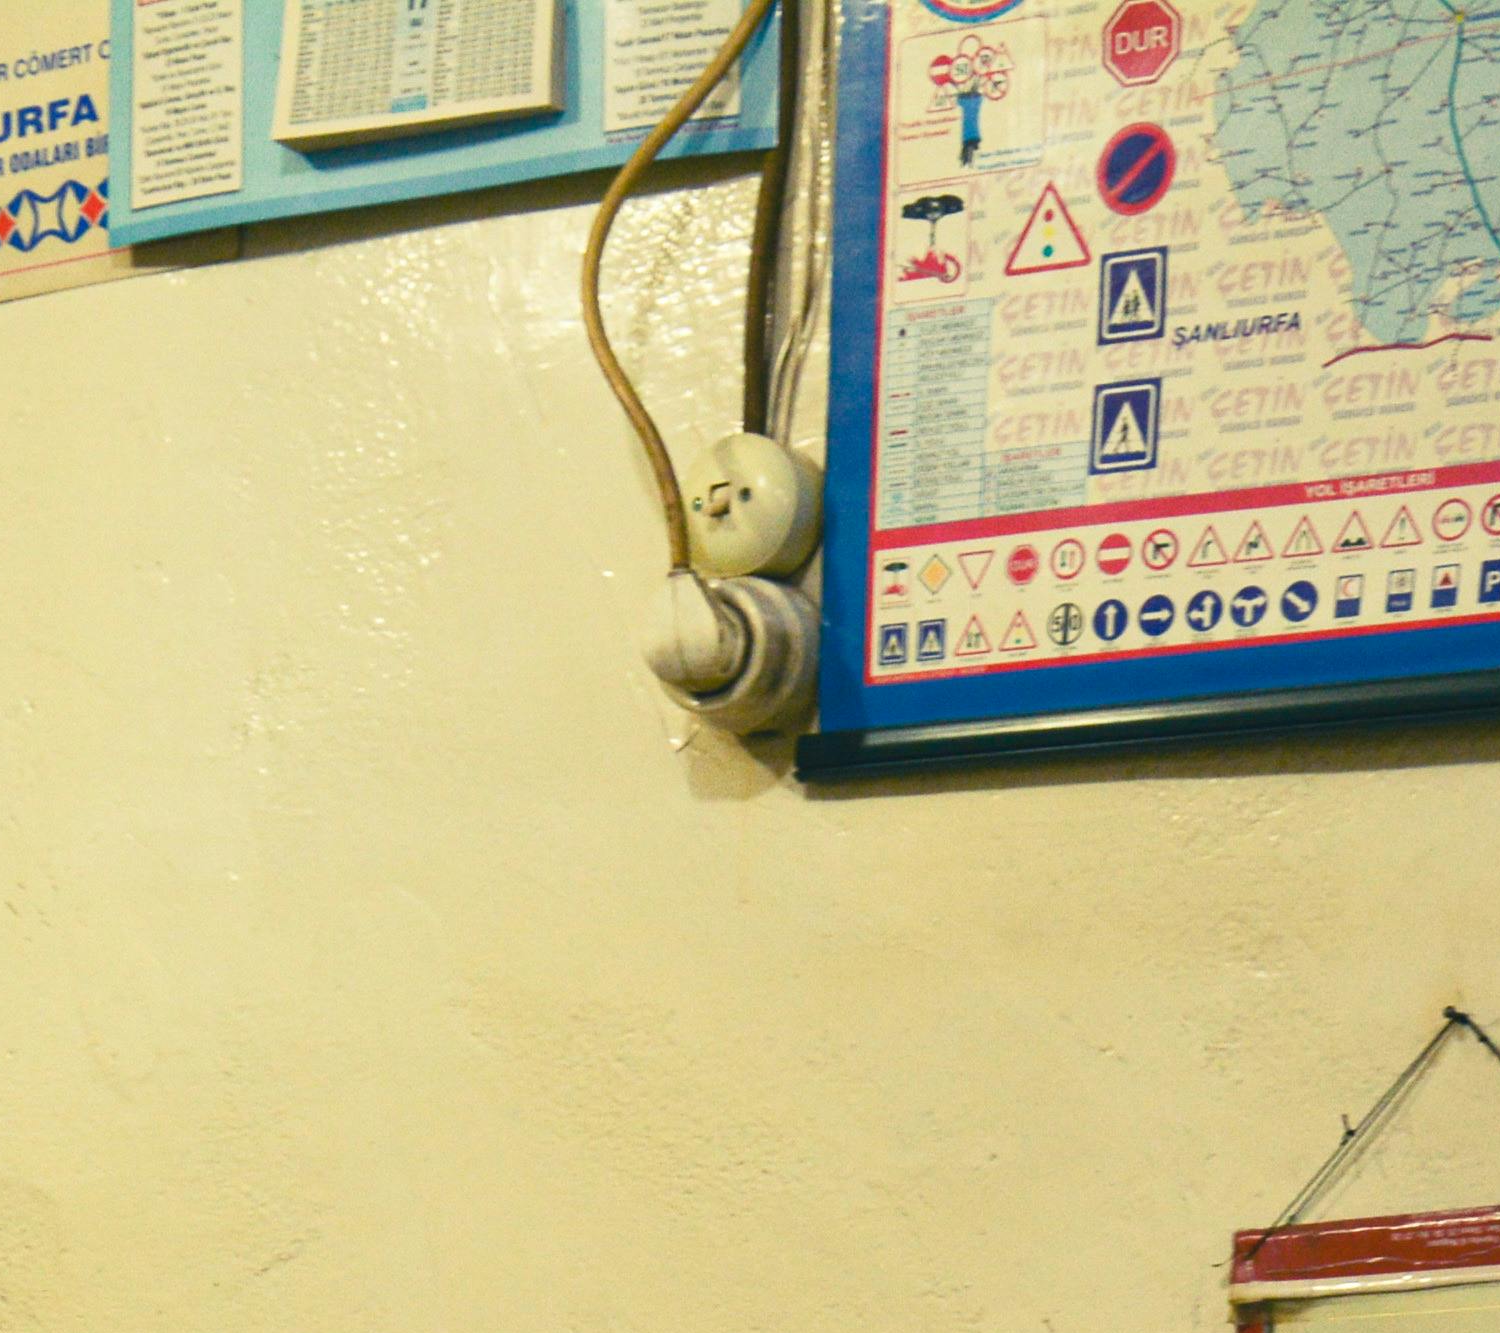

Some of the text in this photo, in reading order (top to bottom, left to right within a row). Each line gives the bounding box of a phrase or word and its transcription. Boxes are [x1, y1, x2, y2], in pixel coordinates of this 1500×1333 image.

[1114, 26, 1169, 56] DUR
[14, 43, 94, 79] CÖMERT
[1172, 312, 1302, 350] ŞANLIURFA
